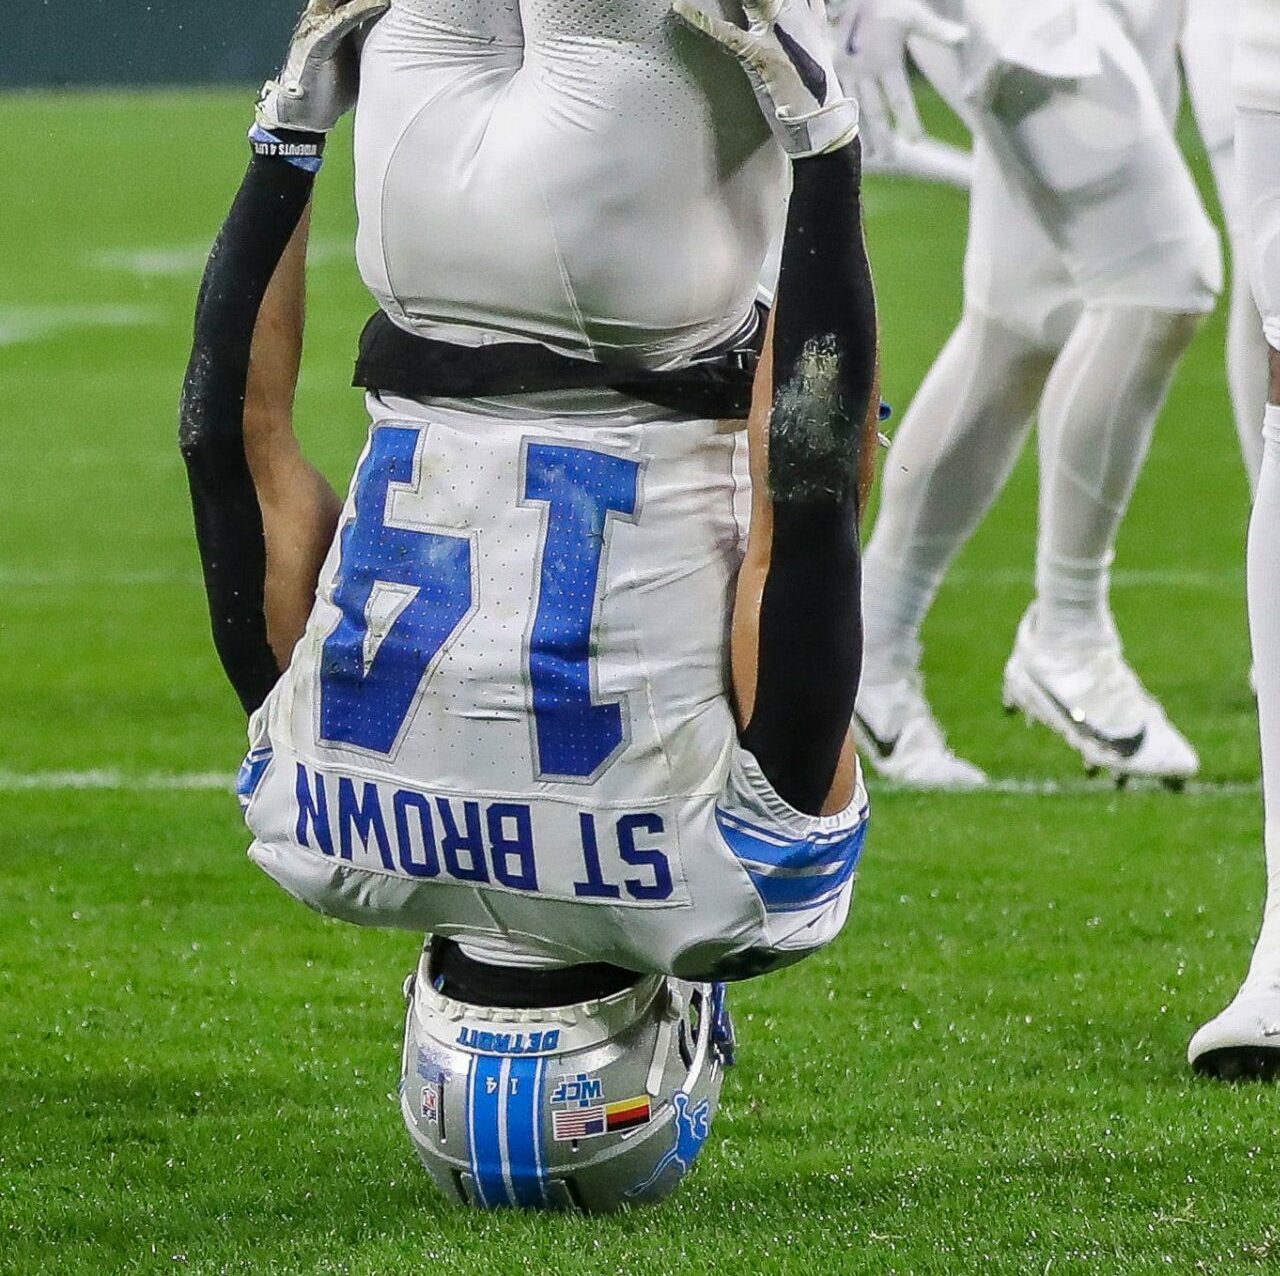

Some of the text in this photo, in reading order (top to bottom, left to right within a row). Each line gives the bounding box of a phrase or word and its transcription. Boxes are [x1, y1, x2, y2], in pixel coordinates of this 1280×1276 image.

[270, 143, 277, 156] 4
[315, 422, 650, 784] 14
[295, 761, 673, 900] ST BROWN
[456, 1026, 560, 1054] DETROIT
[551, 1077, 605, 1103] WCF
